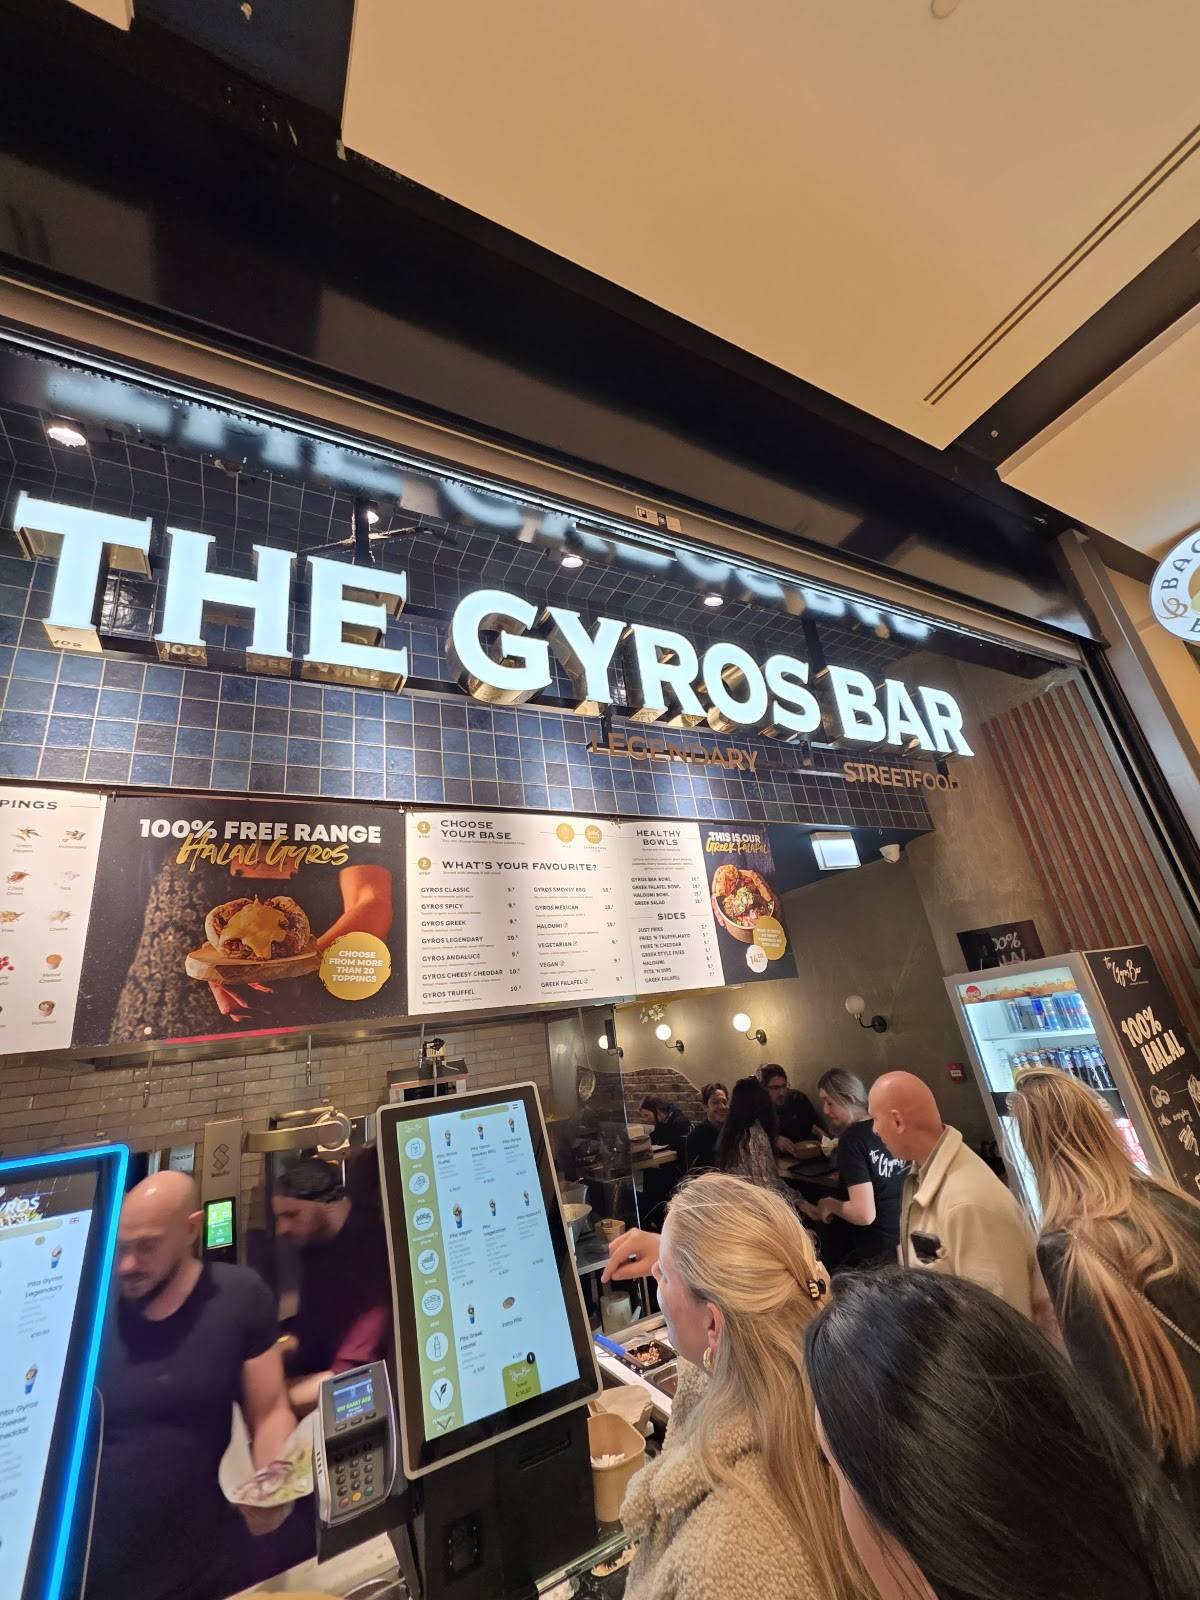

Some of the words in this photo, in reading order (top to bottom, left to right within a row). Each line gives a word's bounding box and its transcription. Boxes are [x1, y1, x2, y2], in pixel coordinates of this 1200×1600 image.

[14, 490, 408, 676] THE
[452, 589, 822, 733] GYROS
[825, 665, 975, 757] BAR
[590, 732, 758, 772] LEGENDARY
[843, 763, 961, 792] STREETFOOD
[440, 820, 494, 829] CHOOSE
[139, 819, 218, 839] 100%
[224, 821, 288, 841] FREE
[294, 823, 382, 844] RANGE
[441, 830, 476, 839] YOUR
[480, 831, 512, 840] BASE
[636, 830, 681, 838] HEALTHY
[708, 831, 731, 842] THIS
[732, 832, 741, 842] IS
[742, 834, 761, 843] OUR
[442, 860, 493, 870] WHAT'S
[497, 861, 528, 870] YOUR
[532, 862, 597, 872] FAVOURITE?
[657, 912, 686, 920] SIDES
[339, 950, 376, 958] CHOOSE
[329, 958, 356, 966] FROM
[357, 959, 384, 967] MORE
[336, 966, 361, 974] THAN
[363, 967, 375, 975] 20
[447, 971, 472, 979] CHEESY
[473, 969, 503, 977] CHEDDAR
[331, 974, 377, 983] TOPPINGS
[422, 991, 446, 999] GYROS
[447, 989, 475, 997] TRUFFEL
[1122, 1005, 1162, 1048] 100%
[1141, 1029, 1186, 1075] HALAL
